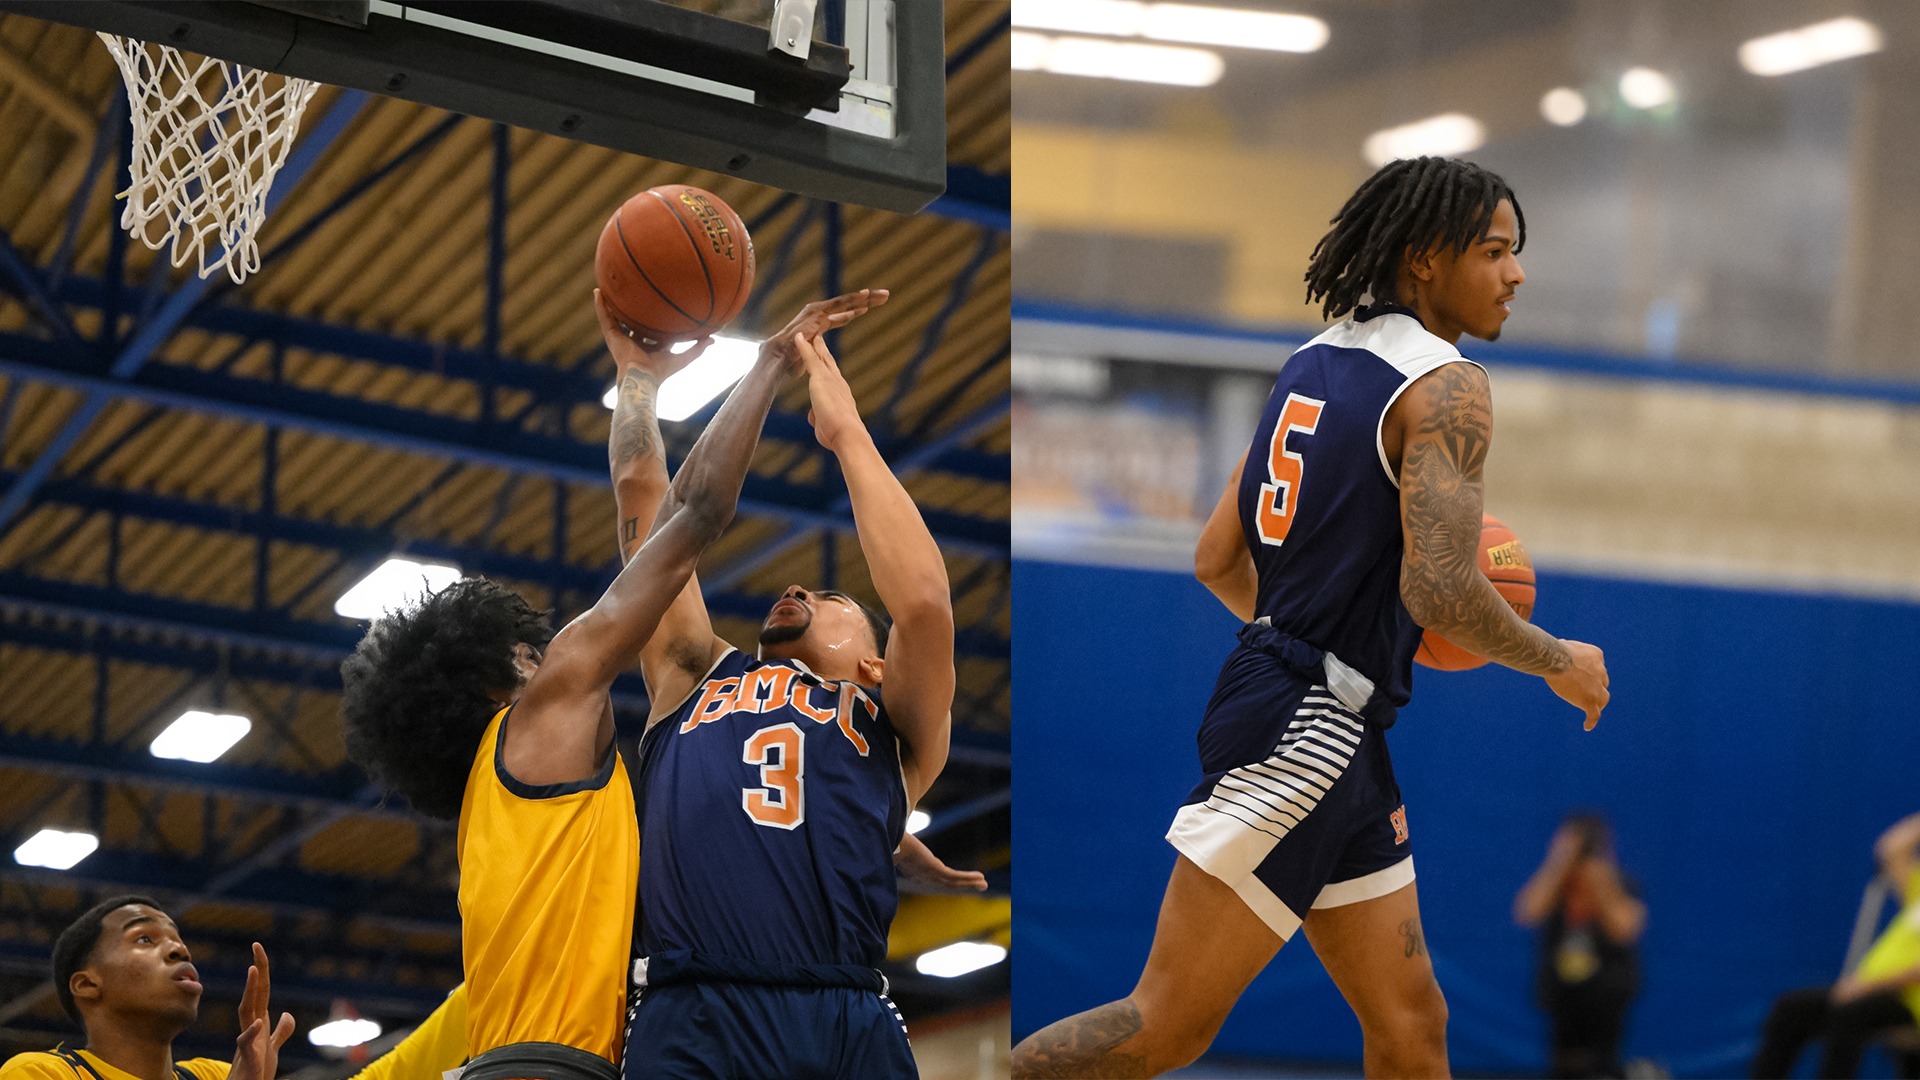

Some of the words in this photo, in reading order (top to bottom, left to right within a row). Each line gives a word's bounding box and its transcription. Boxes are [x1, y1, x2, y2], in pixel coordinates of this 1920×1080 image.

[685, 188, 736, 261] LEGACY
[1255, 392, 1327, 547] 5
[679, 665, 879, 757] BMCC
[742, 722, 806, 831] 3
